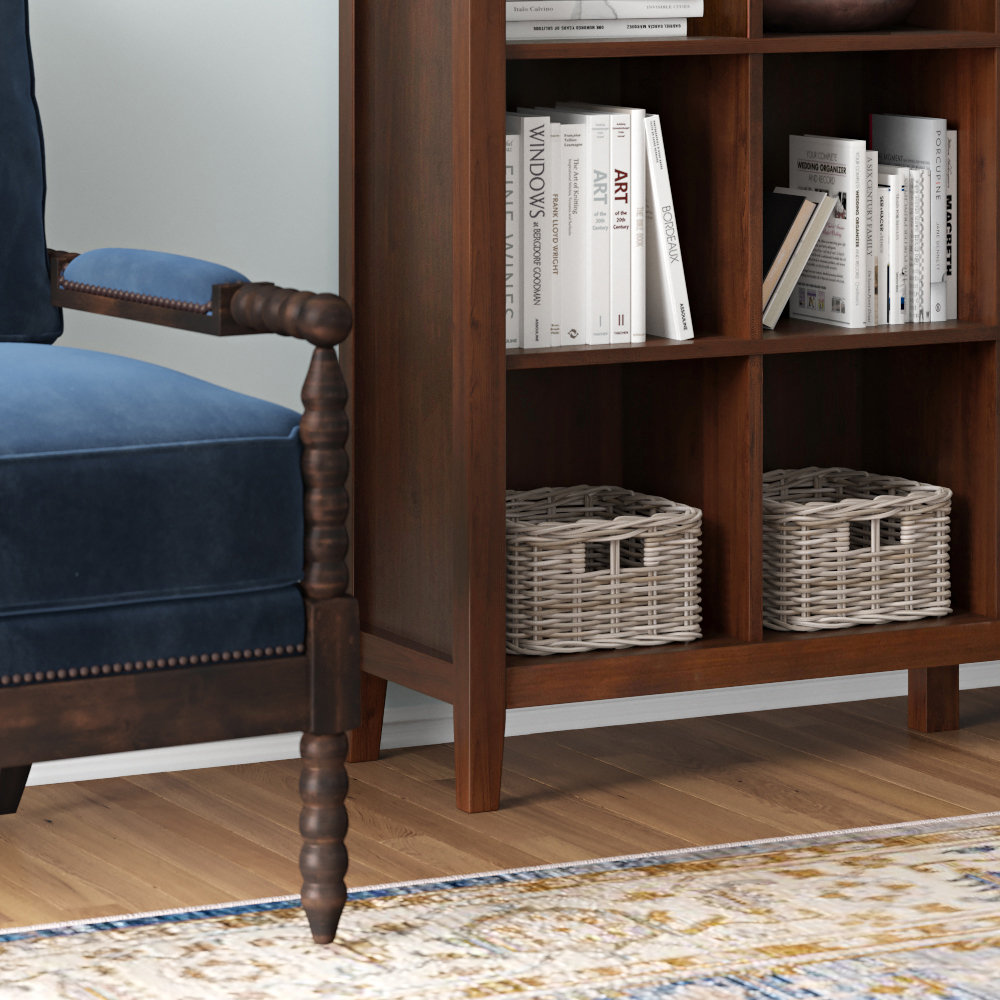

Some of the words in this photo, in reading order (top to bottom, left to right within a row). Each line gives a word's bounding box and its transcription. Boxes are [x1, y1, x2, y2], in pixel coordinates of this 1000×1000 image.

[528, 124, 545, 219] WINDOWS
[593, 168, 608, 205] ART
[614, 168, 628, 204] ART
[797, 161, 819, 171] WEDDING
[819, 163, 847, 174] ORGANIZER
[533, 228, 542, 267] BERGDORF
[661, 205, 680, 264] BORDEAUX
[533, 267, 542, 306] GOODMAN
